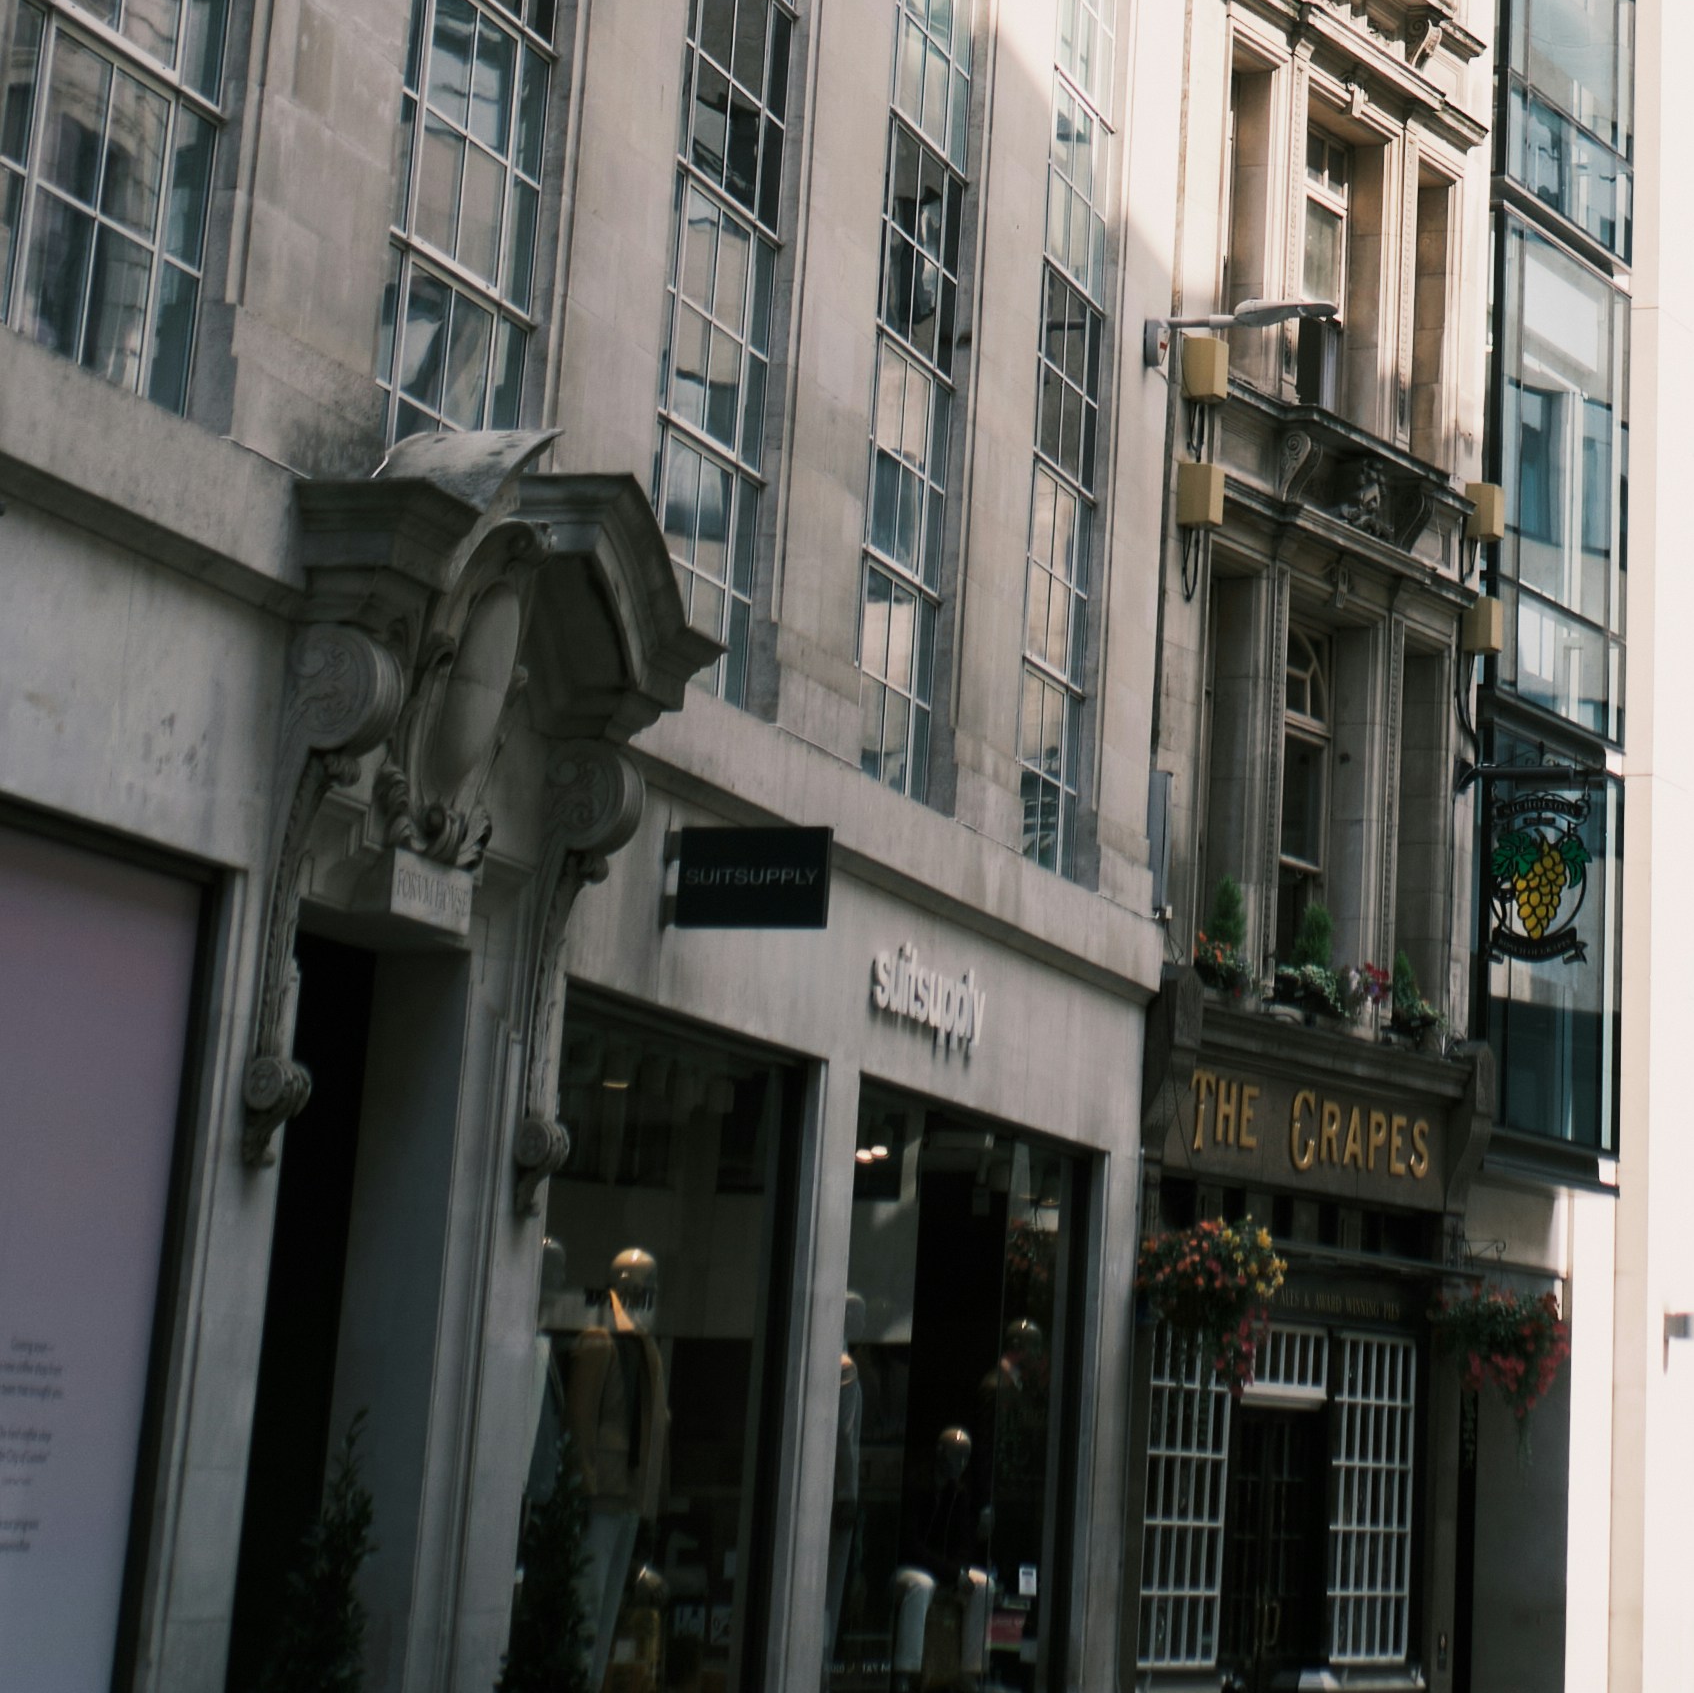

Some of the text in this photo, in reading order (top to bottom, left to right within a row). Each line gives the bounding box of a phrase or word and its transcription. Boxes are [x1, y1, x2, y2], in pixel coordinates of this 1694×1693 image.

[684, 865, 820, 887] SUITSUPPLY
[873, 940, 987, 1050] suitsupply
[1190, 1068, 1430, 1180] THE GRAPES
[1314, 1292, 1343, 1314] AWARD
[1345, 1295, 1379, 1318] WINNING
